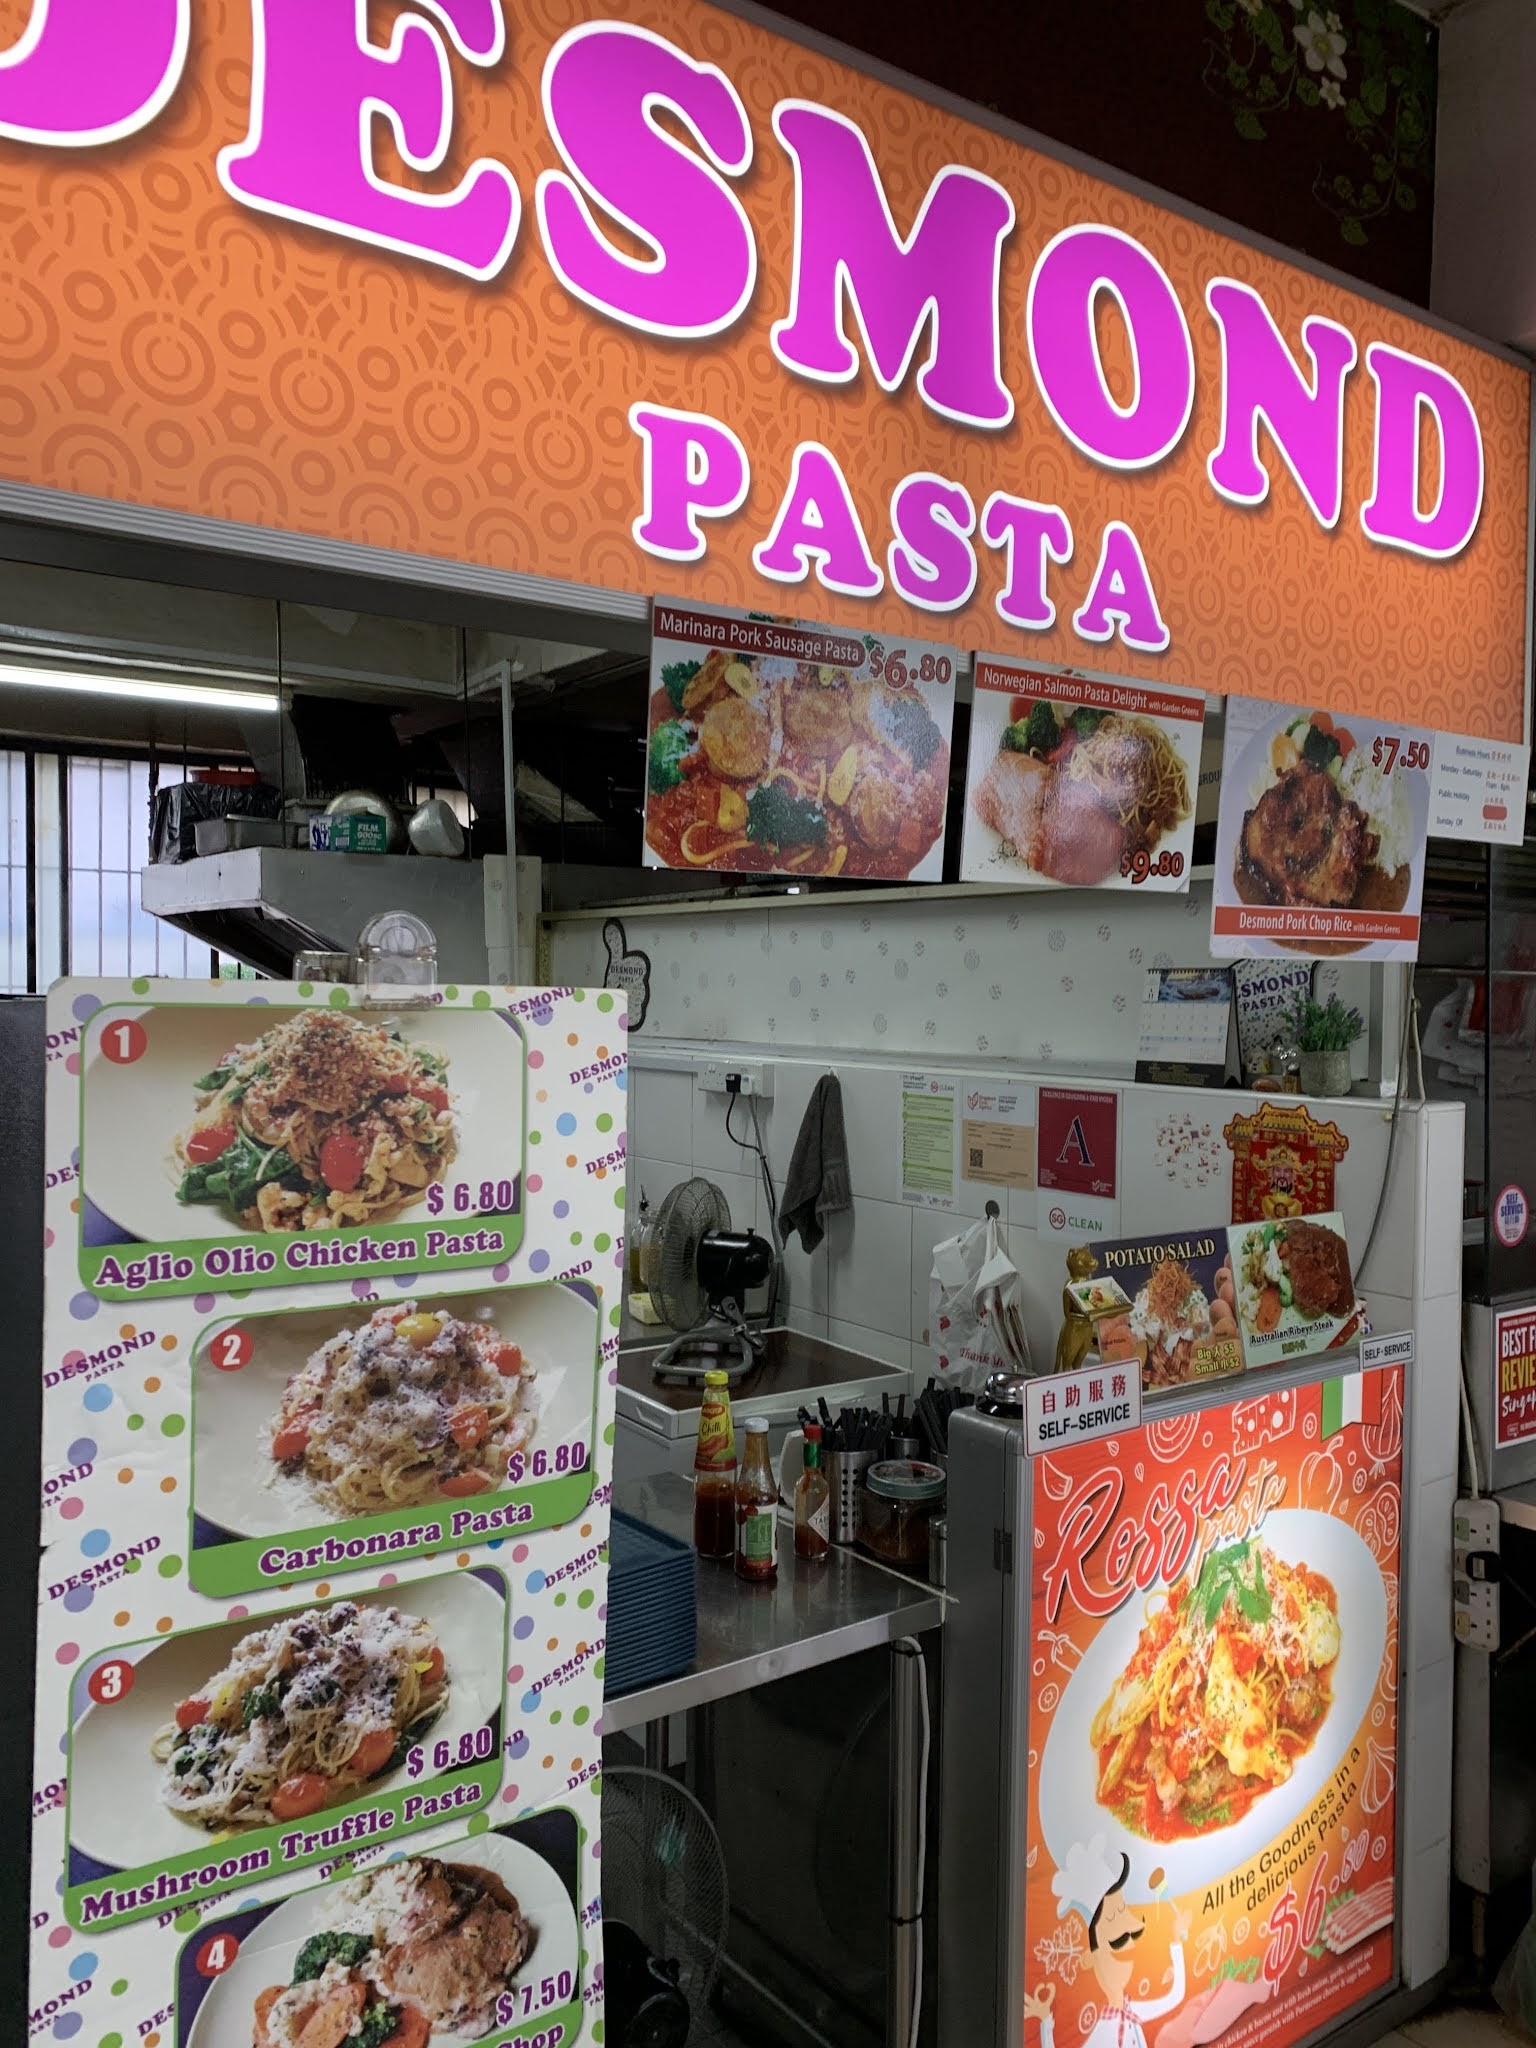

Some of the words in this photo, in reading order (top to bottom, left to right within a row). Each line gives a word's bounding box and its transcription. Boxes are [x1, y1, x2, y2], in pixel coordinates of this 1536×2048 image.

[629, 402, 1170, 651] PASTA
[660, 611, 725, 641] Marinara
[730, 625, 761, 647] Pork
[765, 629, 821, 657] Sausage
[825, 640, 860, 662] Pasta
[869, 644, 952, 690] $6.80
[984, 668, 1041, 693] Norwegian
[1044, 678, 1082, 699] Salmon
[1084, 685, 1110, 703] Pasta
[1112, 690, 1148, 710] Delight
[1371, 736, 1430, 775] $7.50
[1120, 851, 1184, 884] $9.80
[1239, 912, 1284, 929] Desmond
[1286, 914, 1307, 930] Pork
[1309, 915, 1332, 935] Chop
[1334, 915, 1352, 931] Rice
[1353, 922, 1365, 932] with
[1237, 970, 1309, 999] SMOND
[526, 1006, 554, 1021] PASTA
[1243, 995, 1286, 1012] PASTA
[46, 1023, 84, 1049] ON
[113, 1024, 130, 1059] 1
[597, 1068, 624, 1083] PASTA
[1056, 1115, 1096, 1167] A
[1068, 1216, 1102, 1231] CLEAN
[94, 1252, 194, 1291] Aglio
[204, 1246, 276, 1276] Olio
[286, 1236, 417, 1268] Chicken
[425, 1230, 504, 1258] Pasta
[552, 1259, 593, 1281] OND
[1105, 1244, 1164, 1269] POTATO
[1167, 1238, 1216, 1261] SALAD
[1251, 1331, 1289, 1346] Australian
[1289, 1323, 1314, 1337] Ribeye
[1314, 1319, 1334, 1331] Steak
[1502, 1326, 1527, 1358] BEST
[44, 1331, 157, 1389] DESMOND
[221, 1334, 242, 1367] 2
[1195, 1362, 1219, 1375] Small
[1229, 1356, 1241, 1368] $2
[1197, 1348, 1211, 1361] Big
[1224, 1343, 1235, 1354] $5
[85, 1360, 125, 1383] PASTA
[260, 1525, 441, 1575] Carbonara
[451, 1503, 533, 1537] Pasta
[1044, 1453, 1247, 1623] Rossa
[1191, 1458, 1287, 1588] pasta
[48, 1535, 161, 1600] DESMOND
[89, 1568, 131, 1592] PASTA
[571, 1560, 598, 1581] PASTA
[101, 1665, 122, 1699] 3
[531, 1638, 606, 1696] DESMOND
[558, 1664, 586, 1687] PASTA
[1202, 1887, 1225, 1915] All
[1229, 1873, 1256, 1906] the
[1258, 1790, 1336, 1873] Goodness
[1335, 1766, 1351, 1797] in
[1350, 1746, 1361, 1762] a
[1246, 1838, 1317, 1912] delicious
[1317, 1781, 1358, 1841] Pasta
[80, 1848, 270, 1925] Mushroom
[280, 1808, 395, 1859] Truffle
[403, 1783, 482, 1823] Pasta
[1262, 1830, 1369, 1997] $6.80
[207, 1938, 226, 1970] 4
